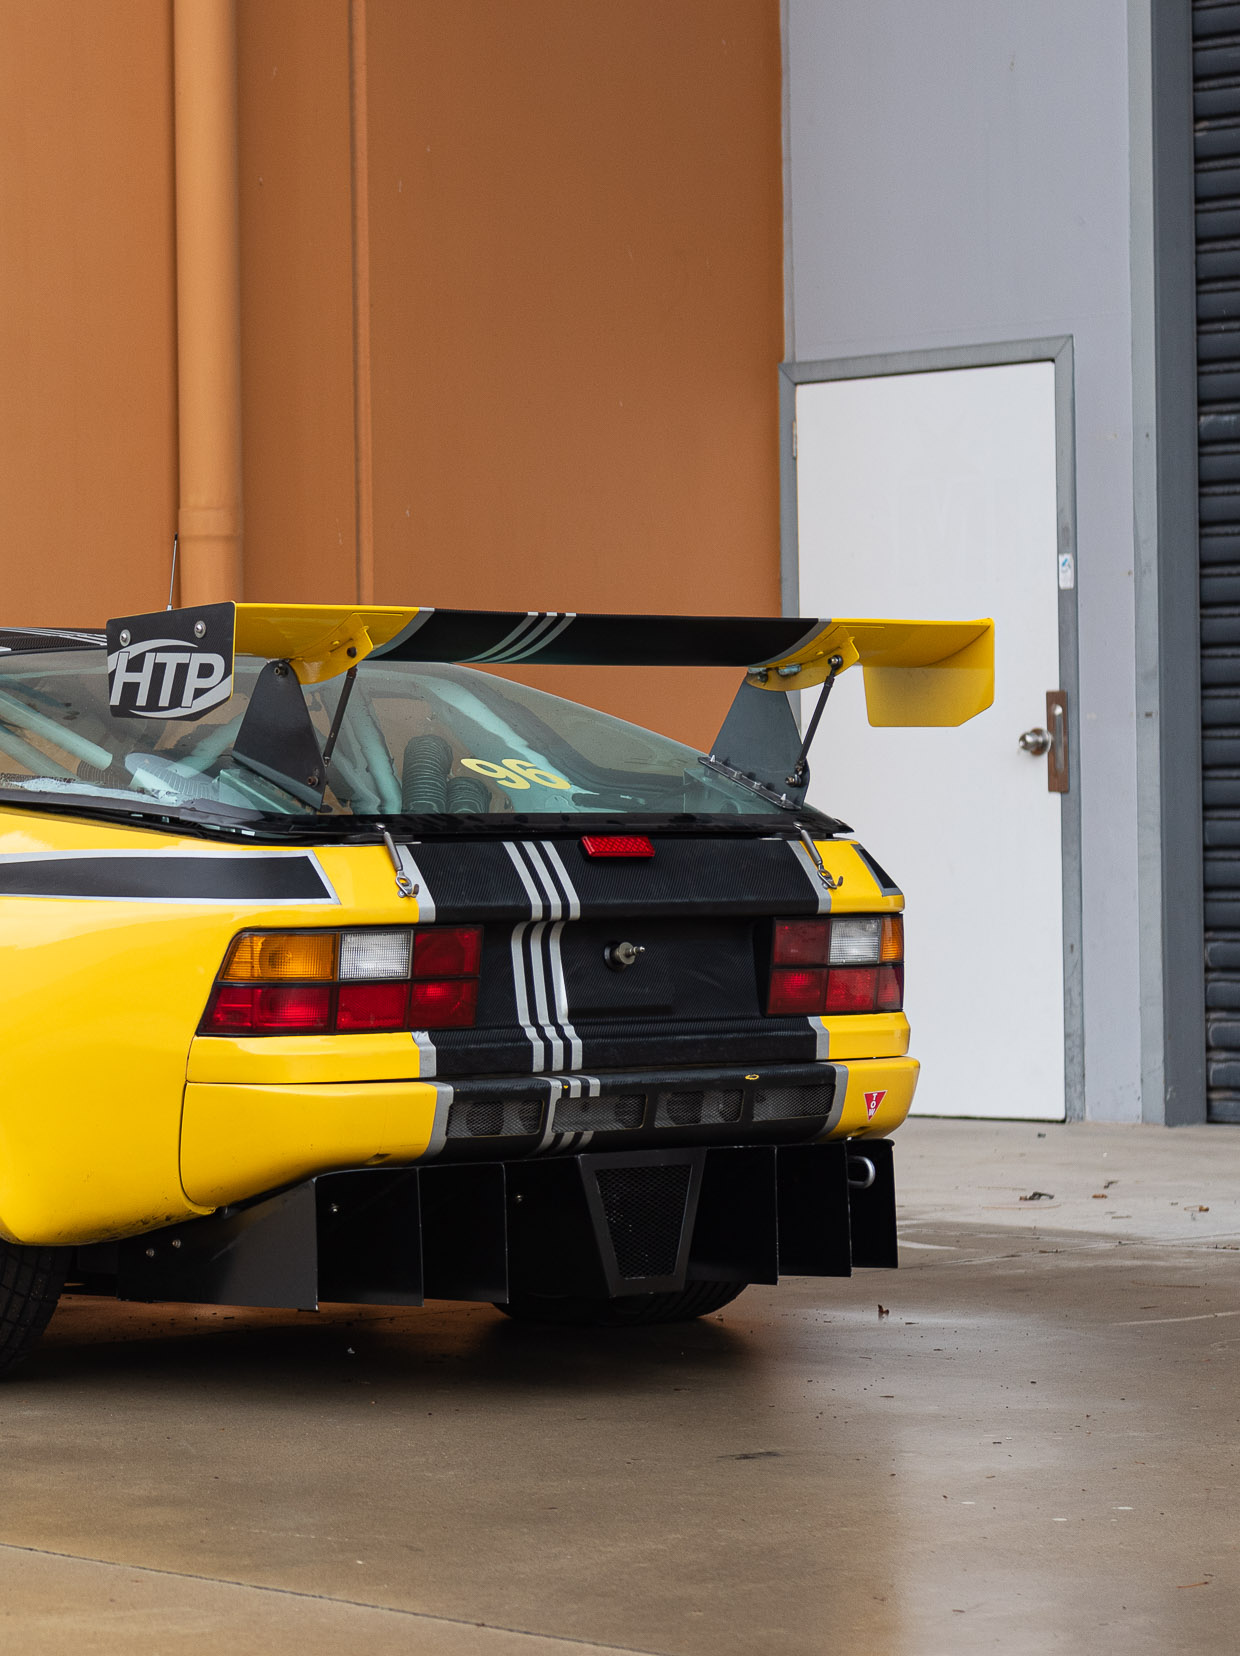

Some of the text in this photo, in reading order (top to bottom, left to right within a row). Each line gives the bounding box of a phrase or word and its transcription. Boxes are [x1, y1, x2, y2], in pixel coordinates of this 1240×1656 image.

[110, 651, 226, 708] HTP
[460, 758, 572, 790] 96
[868, 1093, 878, 1116] TOW
